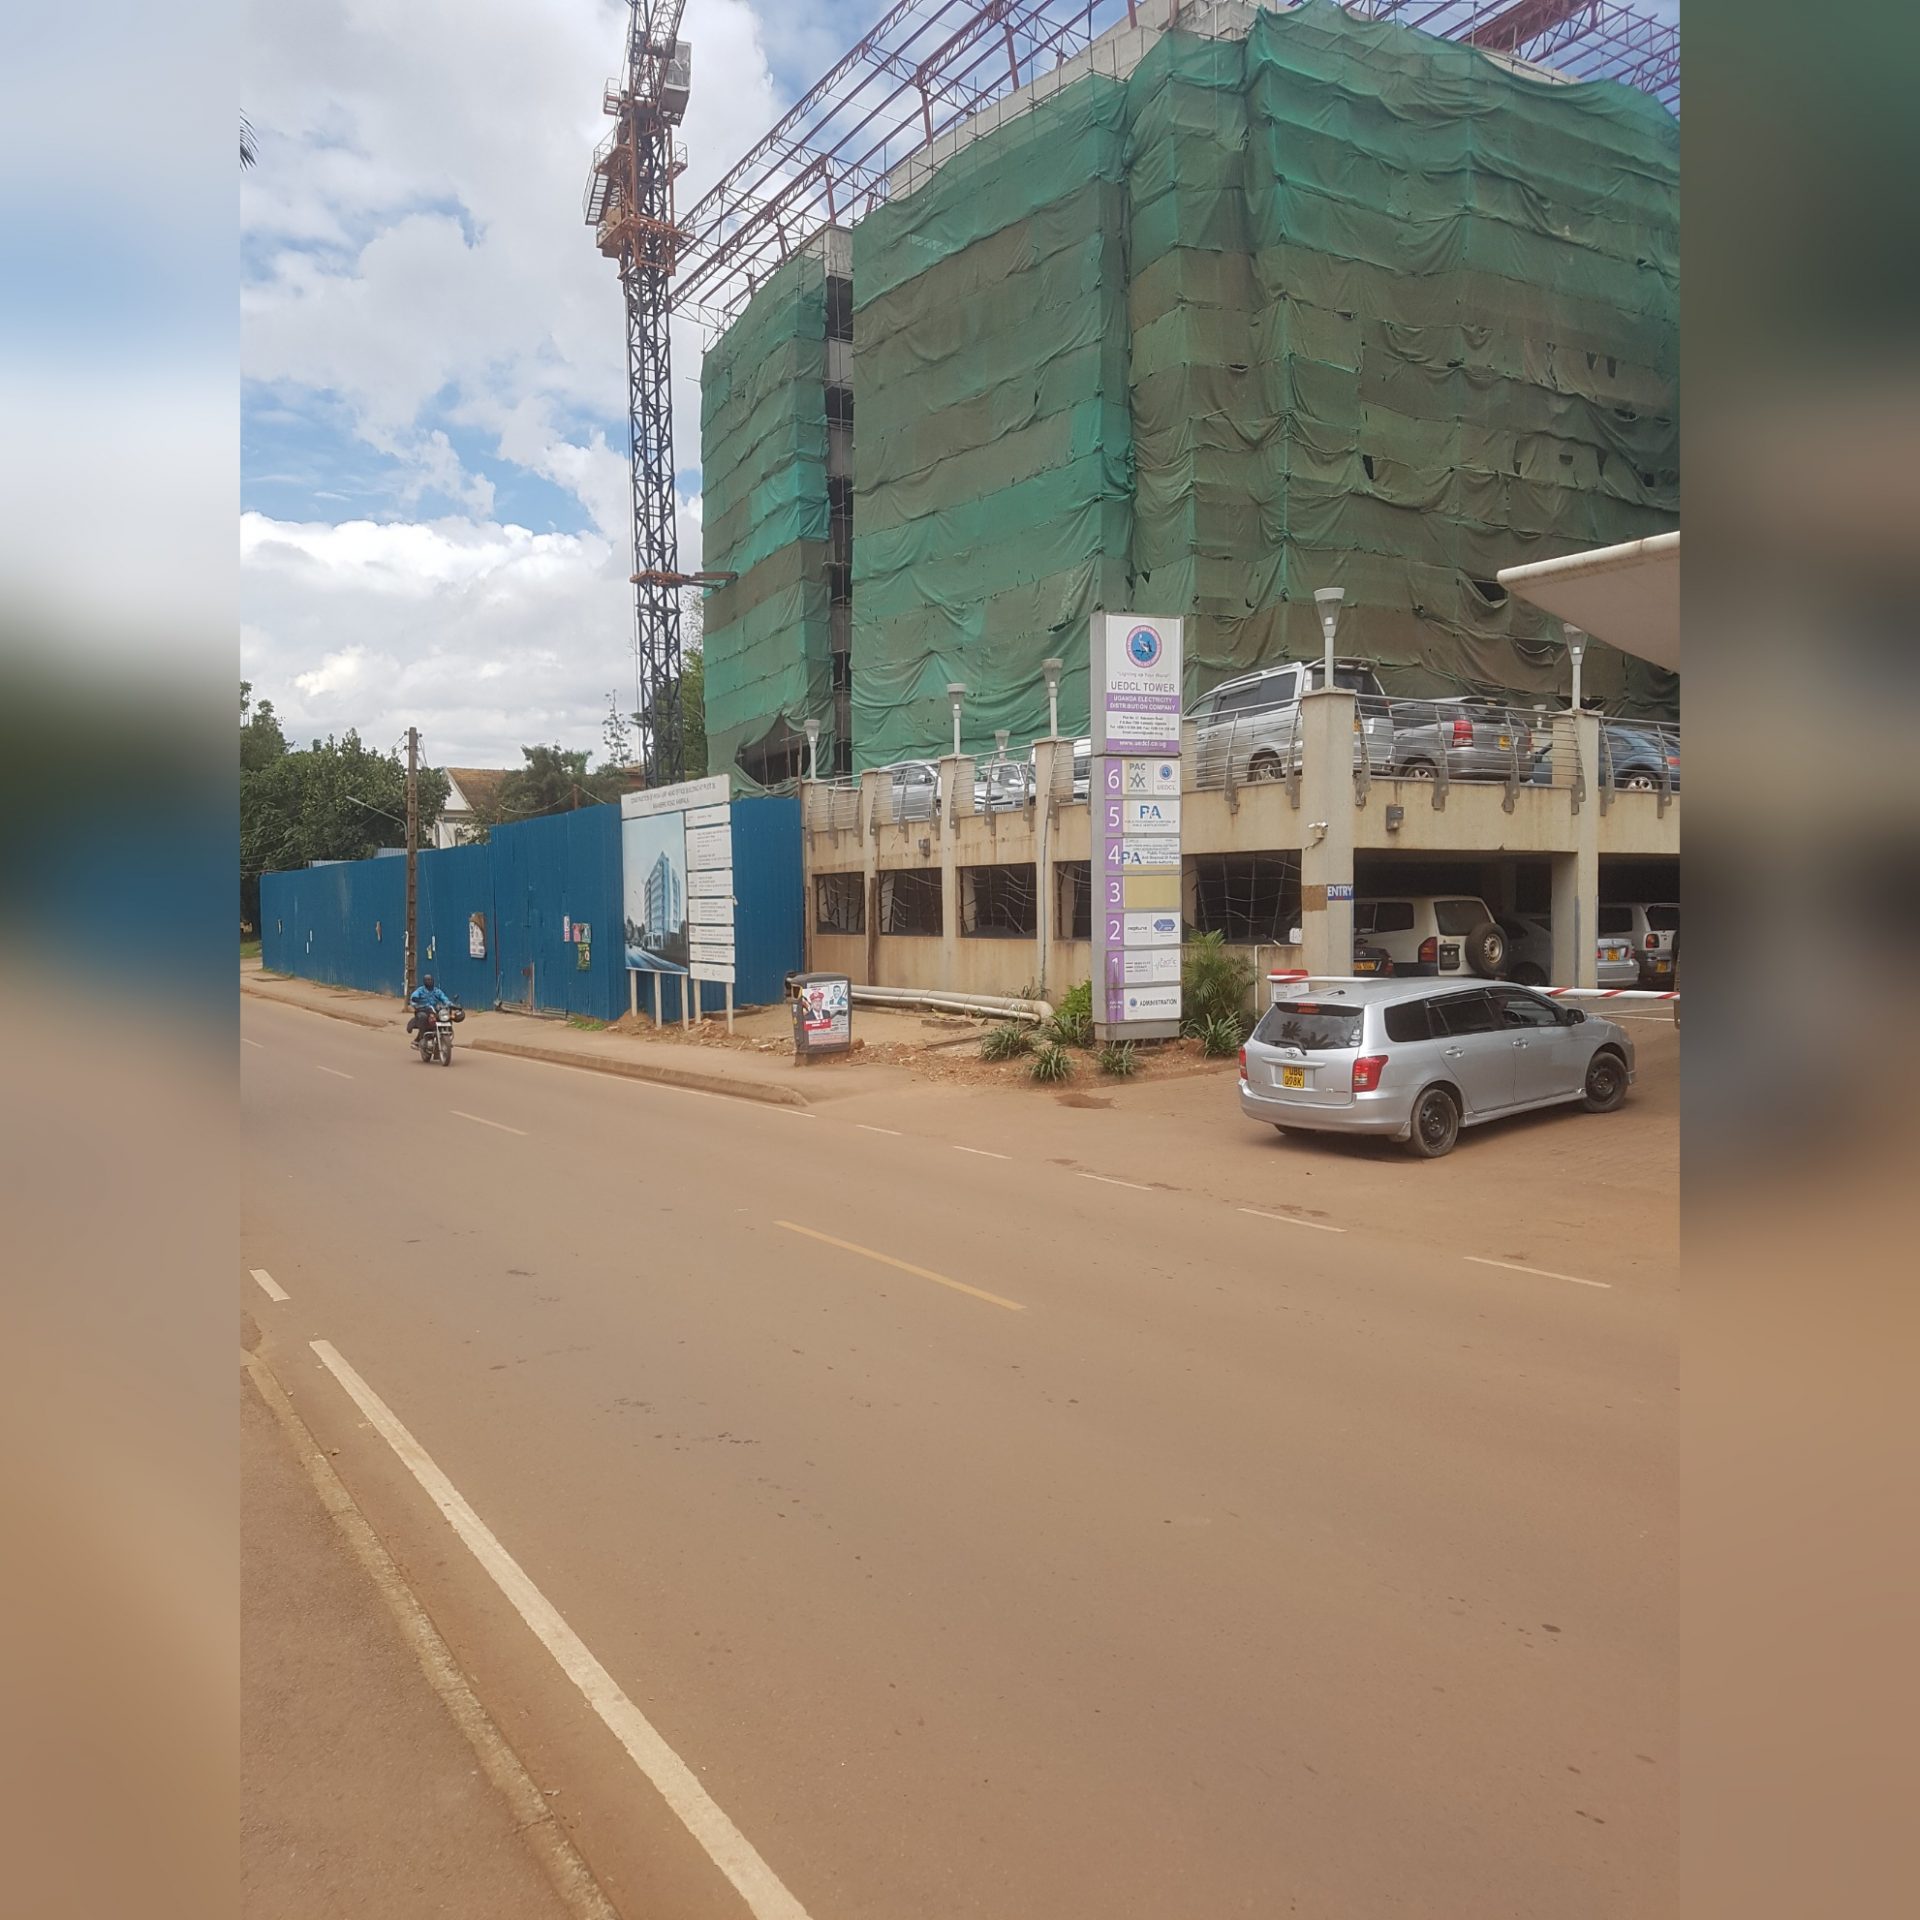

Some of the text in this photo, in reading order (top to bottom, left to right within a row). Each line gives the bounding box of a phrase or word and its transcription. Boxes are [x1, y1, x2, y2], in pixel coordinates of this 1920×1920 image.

[1111, 681, 1175, 693] UEDCL TOWER
[1113, 694, 1172, 703] UGANDA ELECTRICITY
[1110, 702, 1148, 710] DISTRIBUTION
[1129, 763, 1146, 771] PAC
[1107, 769, 1120, 789] 6
[1108, 806, 1120, 827] 5
[1108, 845, 1121, 865] 4
[1109, 882, 1120, 903] 3
[1327, 885, 1353, 897] ENTRY
[1109, 920, 1121, 940] 2
[1139, 998, 1178, 1007] ADMINISTRATION
